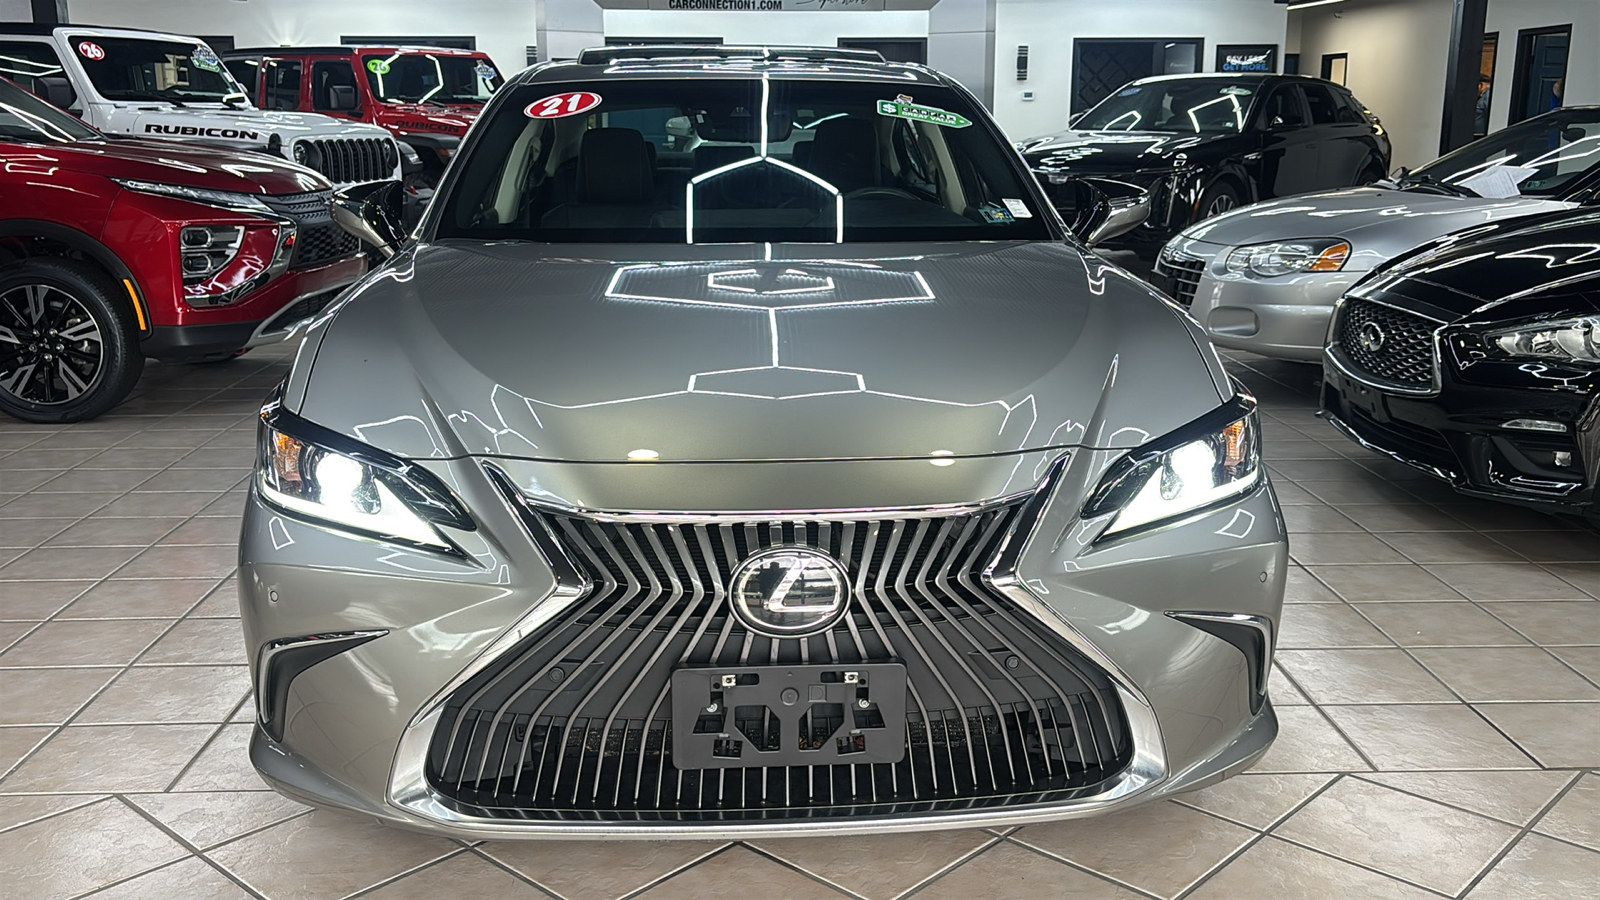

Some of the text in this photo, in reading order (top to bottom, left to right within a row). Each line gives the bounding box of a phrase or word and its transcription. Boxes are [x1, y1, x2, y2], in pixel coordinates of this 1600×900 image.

[668, 0, 783, 10] CARCONNECTION1.COM
[82, 44, 101, 58] 26
[539, 94, 582, 116] 21
[901, 111, 957, 125] GREAT VALUE
[144, 124, 259, 140] RUBICON
[396, 121, 460, 132] RUBICON
